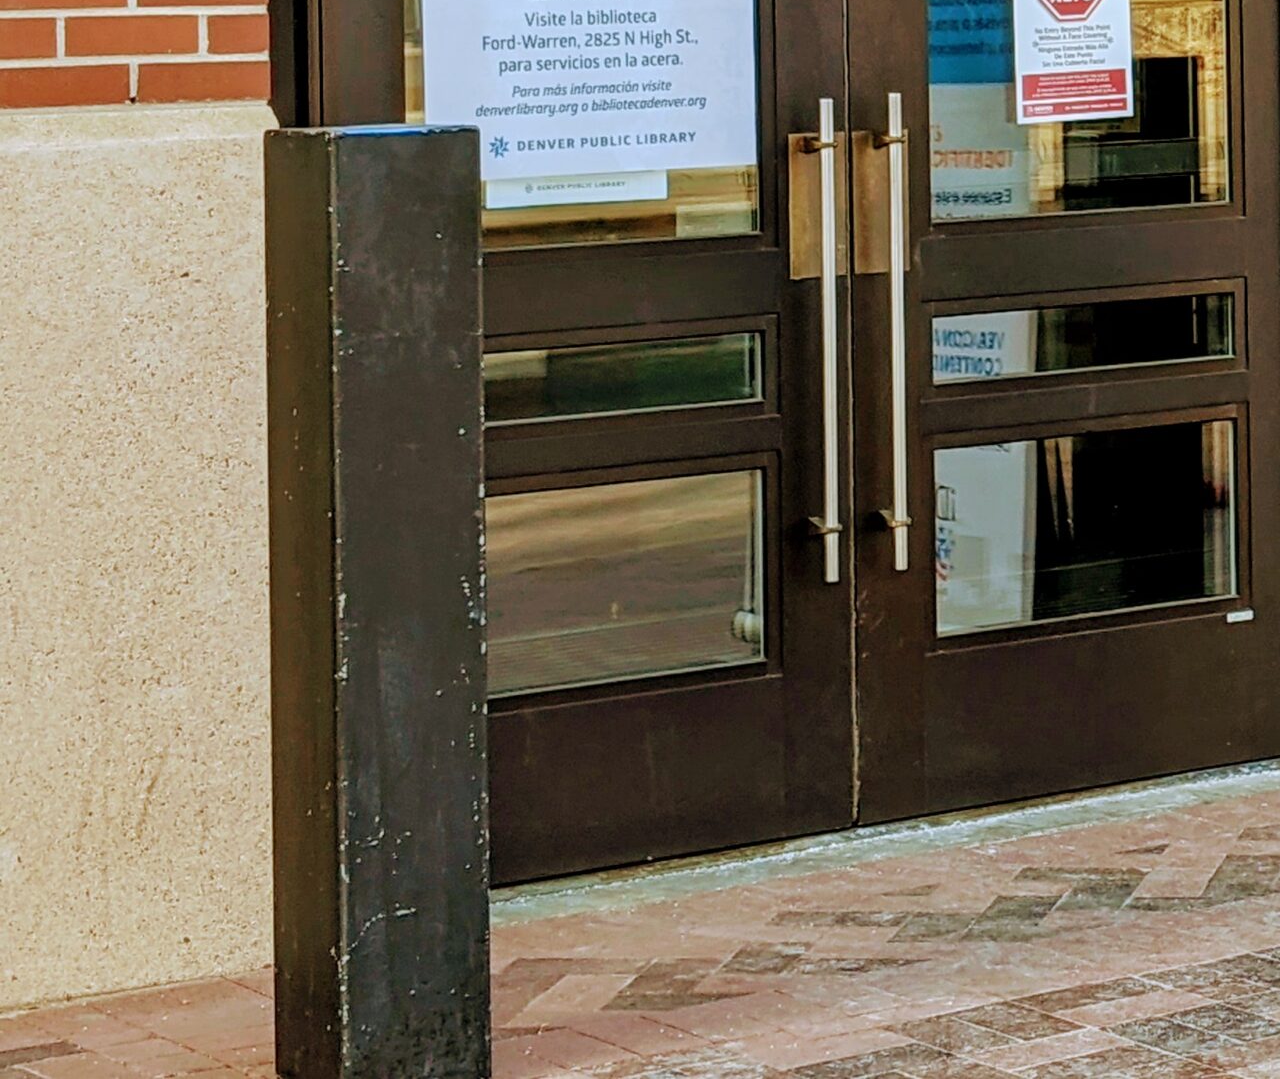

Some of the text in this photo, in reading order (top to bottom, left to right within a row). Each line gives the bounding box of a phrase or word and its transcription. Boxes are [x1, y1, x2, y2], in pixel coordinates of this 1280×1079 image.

[517, 131, 696, 151] DENVER PUBLIC LIBRARY
